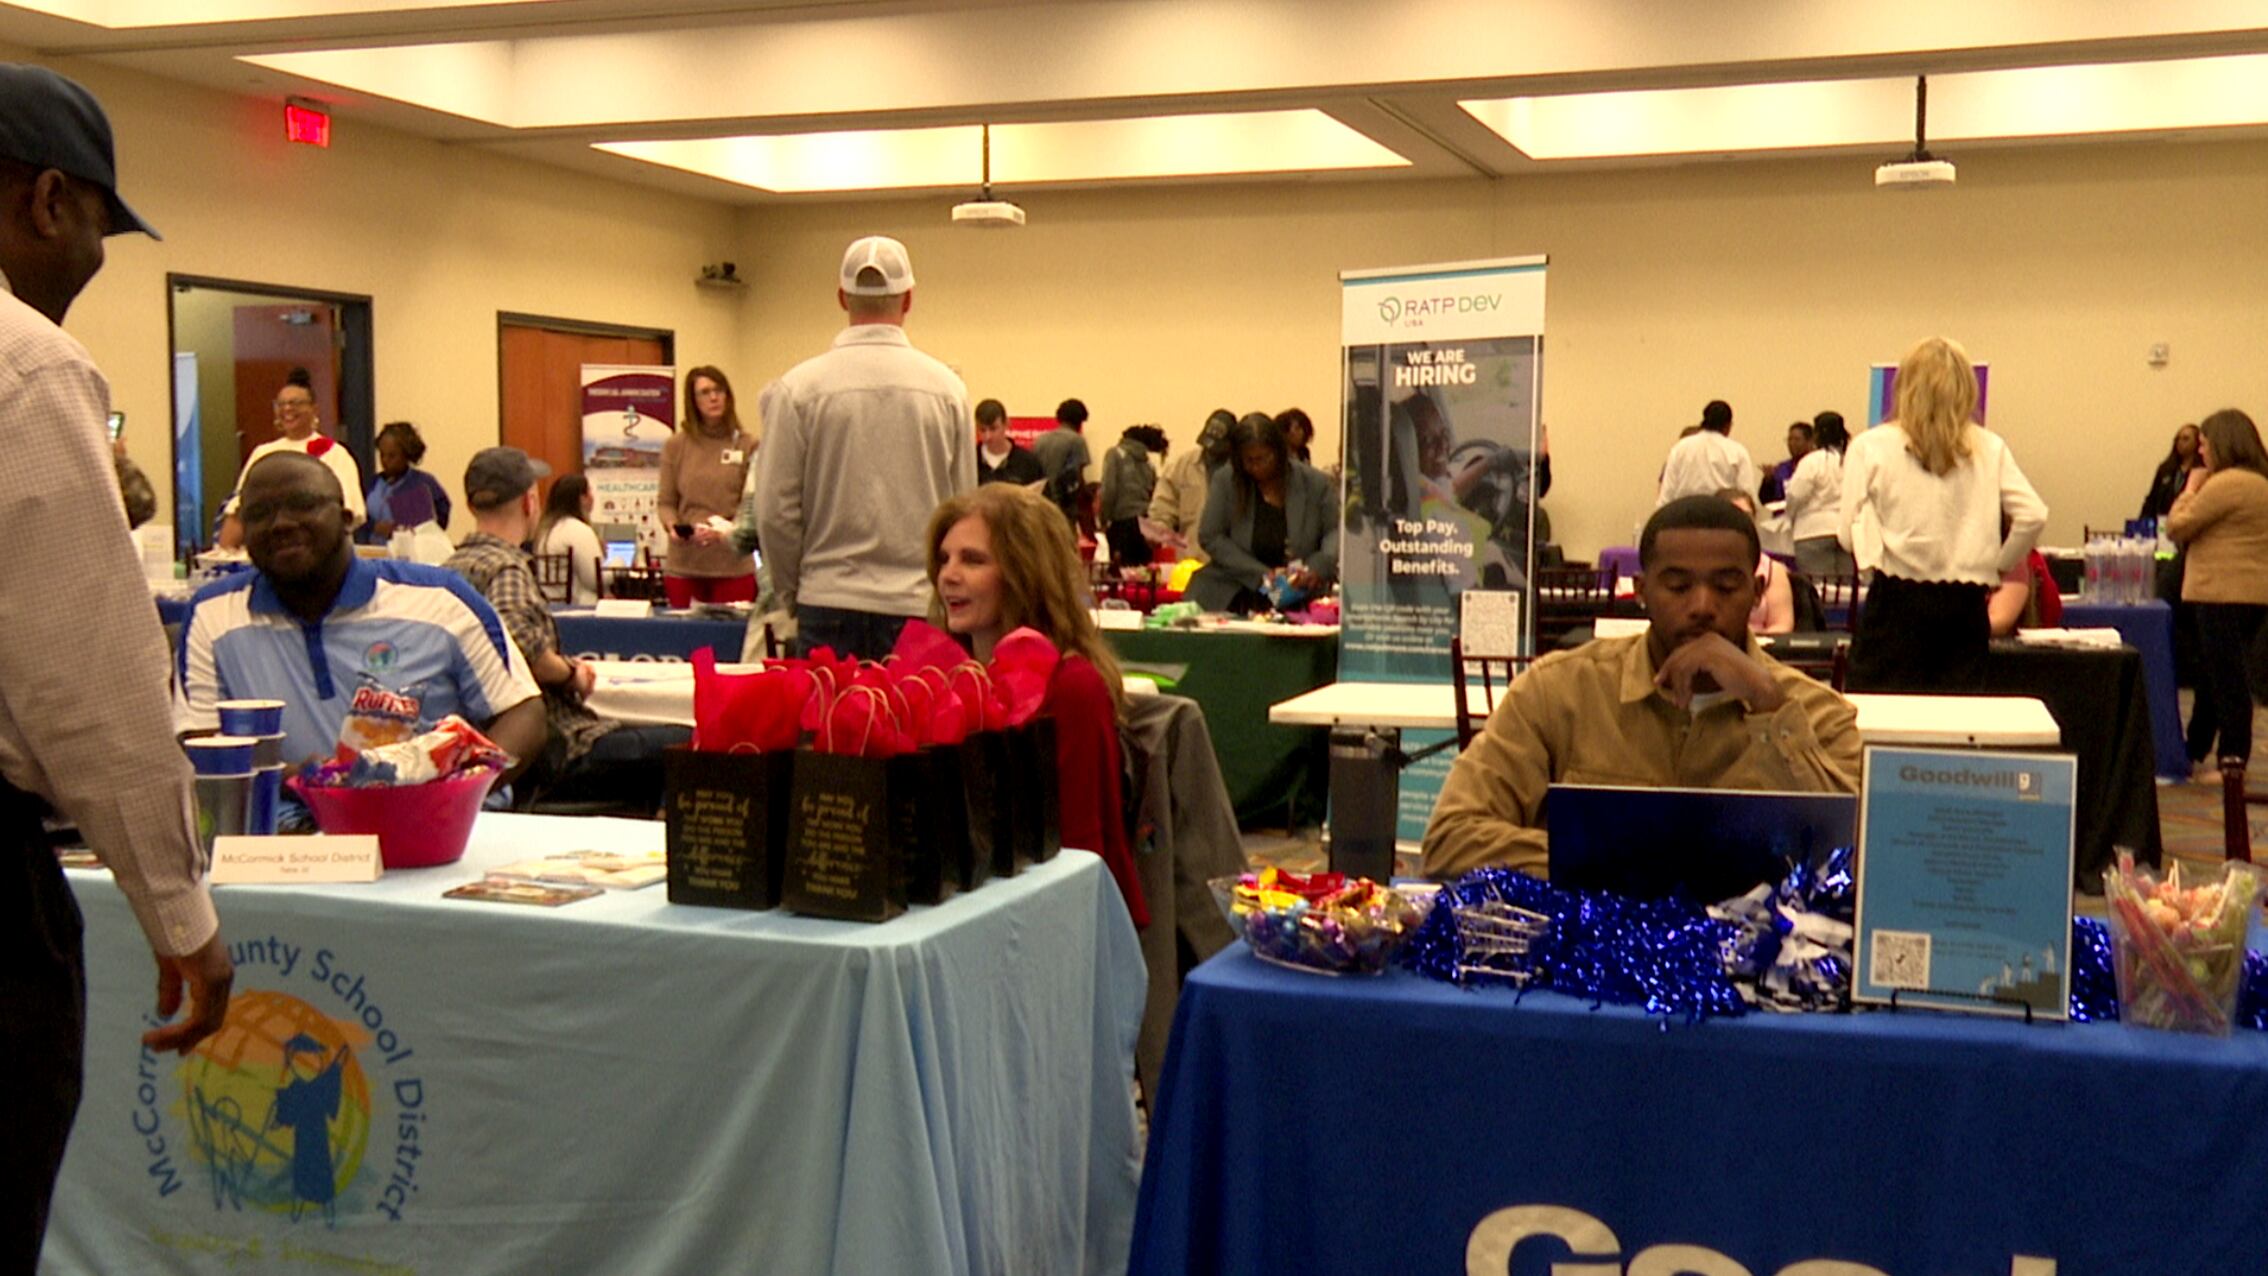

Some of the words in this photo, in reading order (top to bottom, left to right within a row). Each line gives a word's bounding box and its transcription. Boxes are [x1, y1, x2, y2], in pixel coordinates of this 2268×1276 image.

[1404, 297, 1456, 317] RATP
[1407, 351, 1432, 364] WE
[1435, 349, 1465, 363] ARE
[1395, 363, 1476, 387] HIRING
[1396, 519, 1423, 535] Top
[1426, 519, 1458, 535] Pay.
[1379, 538, 1474, 558] Outstanding
[1392, 559, 1460, 574] Benefits.
[1900, 765, 2017, 789] Goodwill
[221, 852, 284, 865] McCormick
[289, 851, 329, 863] School
[331, 851, 370, 864] District
[227, 935, 302, 977] unty
[311, 949, 413, 1064] School
[377, 1079, 427, 1222] District
